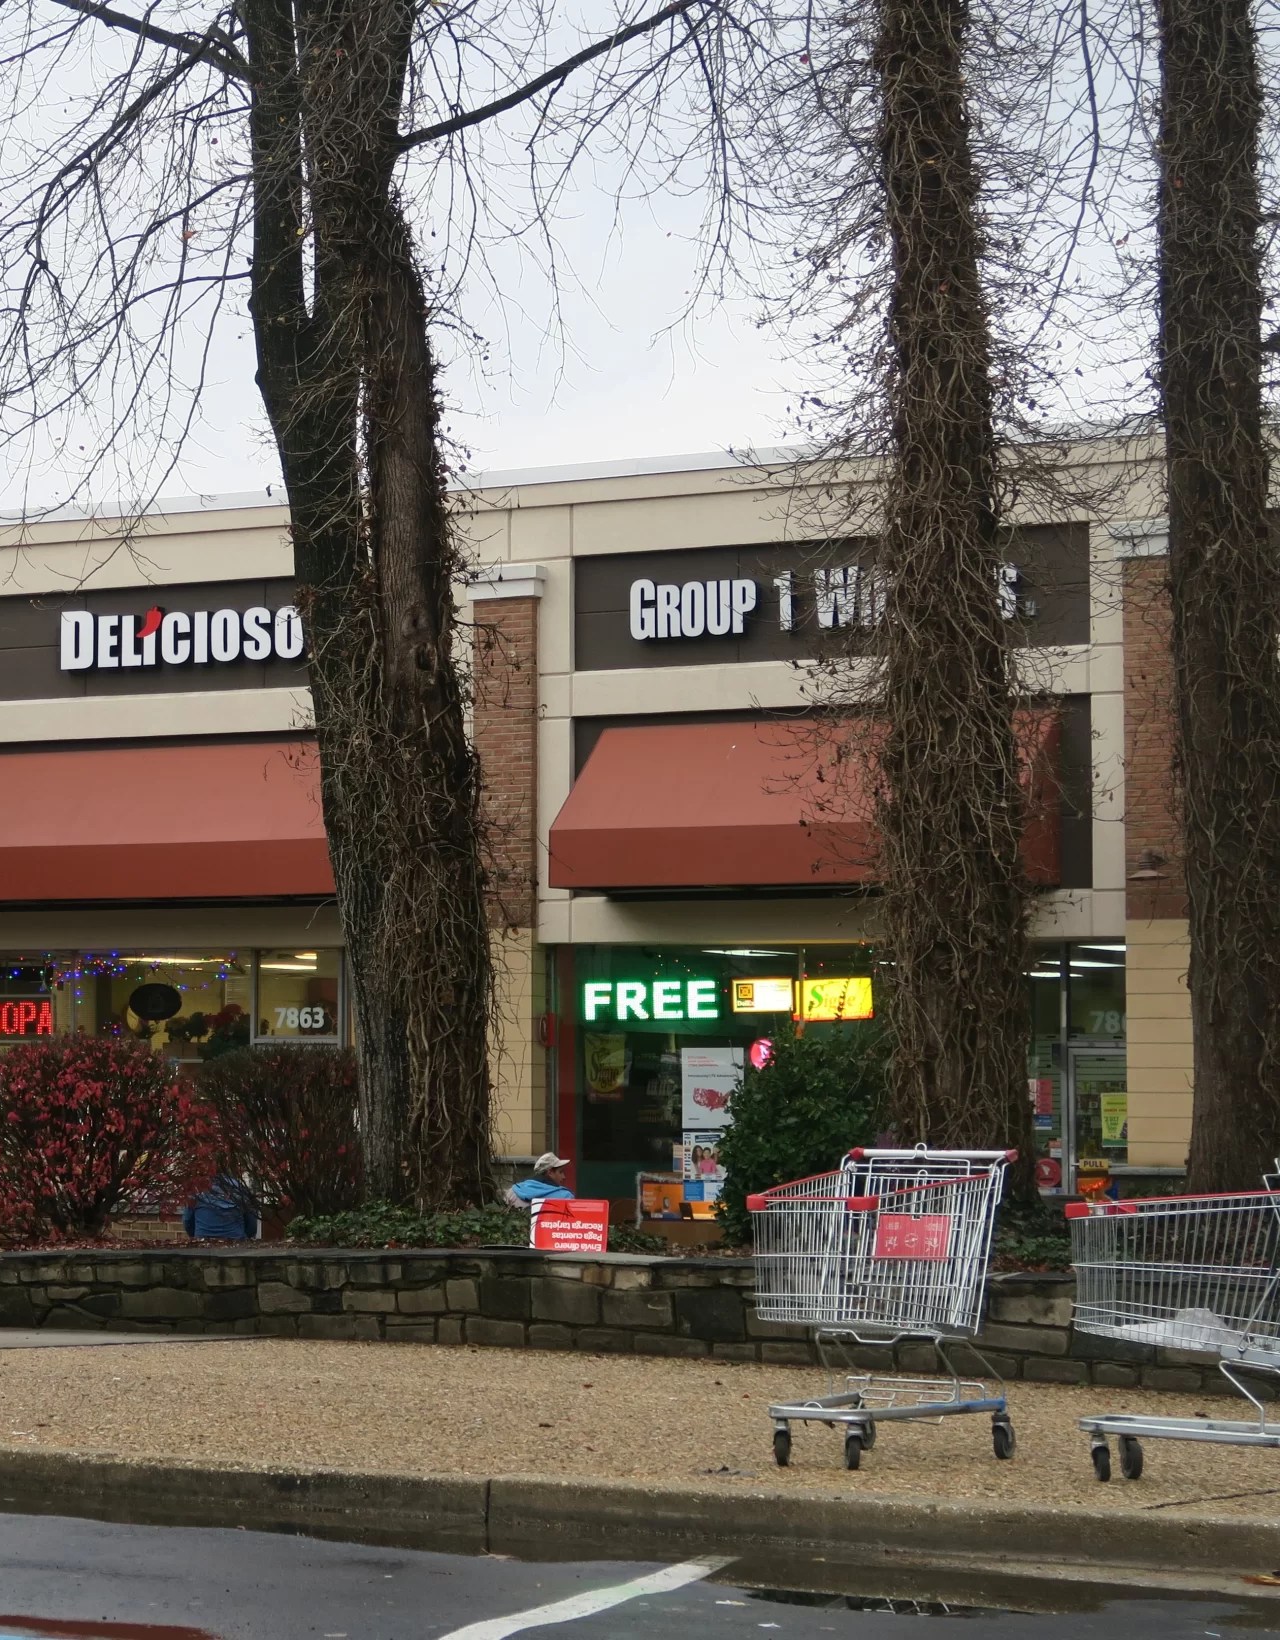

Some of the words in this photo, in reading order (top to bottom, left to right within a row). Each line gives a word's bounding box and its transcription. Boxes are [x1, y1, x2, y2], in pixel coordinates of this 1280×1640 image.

[629, 578, 757, 640] GROUP
[773, 570, 793, 631] 1
[60, 605, 305, 670] DELICIOSO
[584, 980, 718, 1020] FREE
[274, 1006, 325, 1029] 7863
[1089, 1011, 1126, 1034] 78
[1083, 1160, 1105, 1168] PULL
[541, 1221, 570, 1231] tarjetas
[572, 1221, 603, 1231] Recarga
[584, 1231, 602, 1241] Paga
[555, 1242, 579, 1251] dinero
